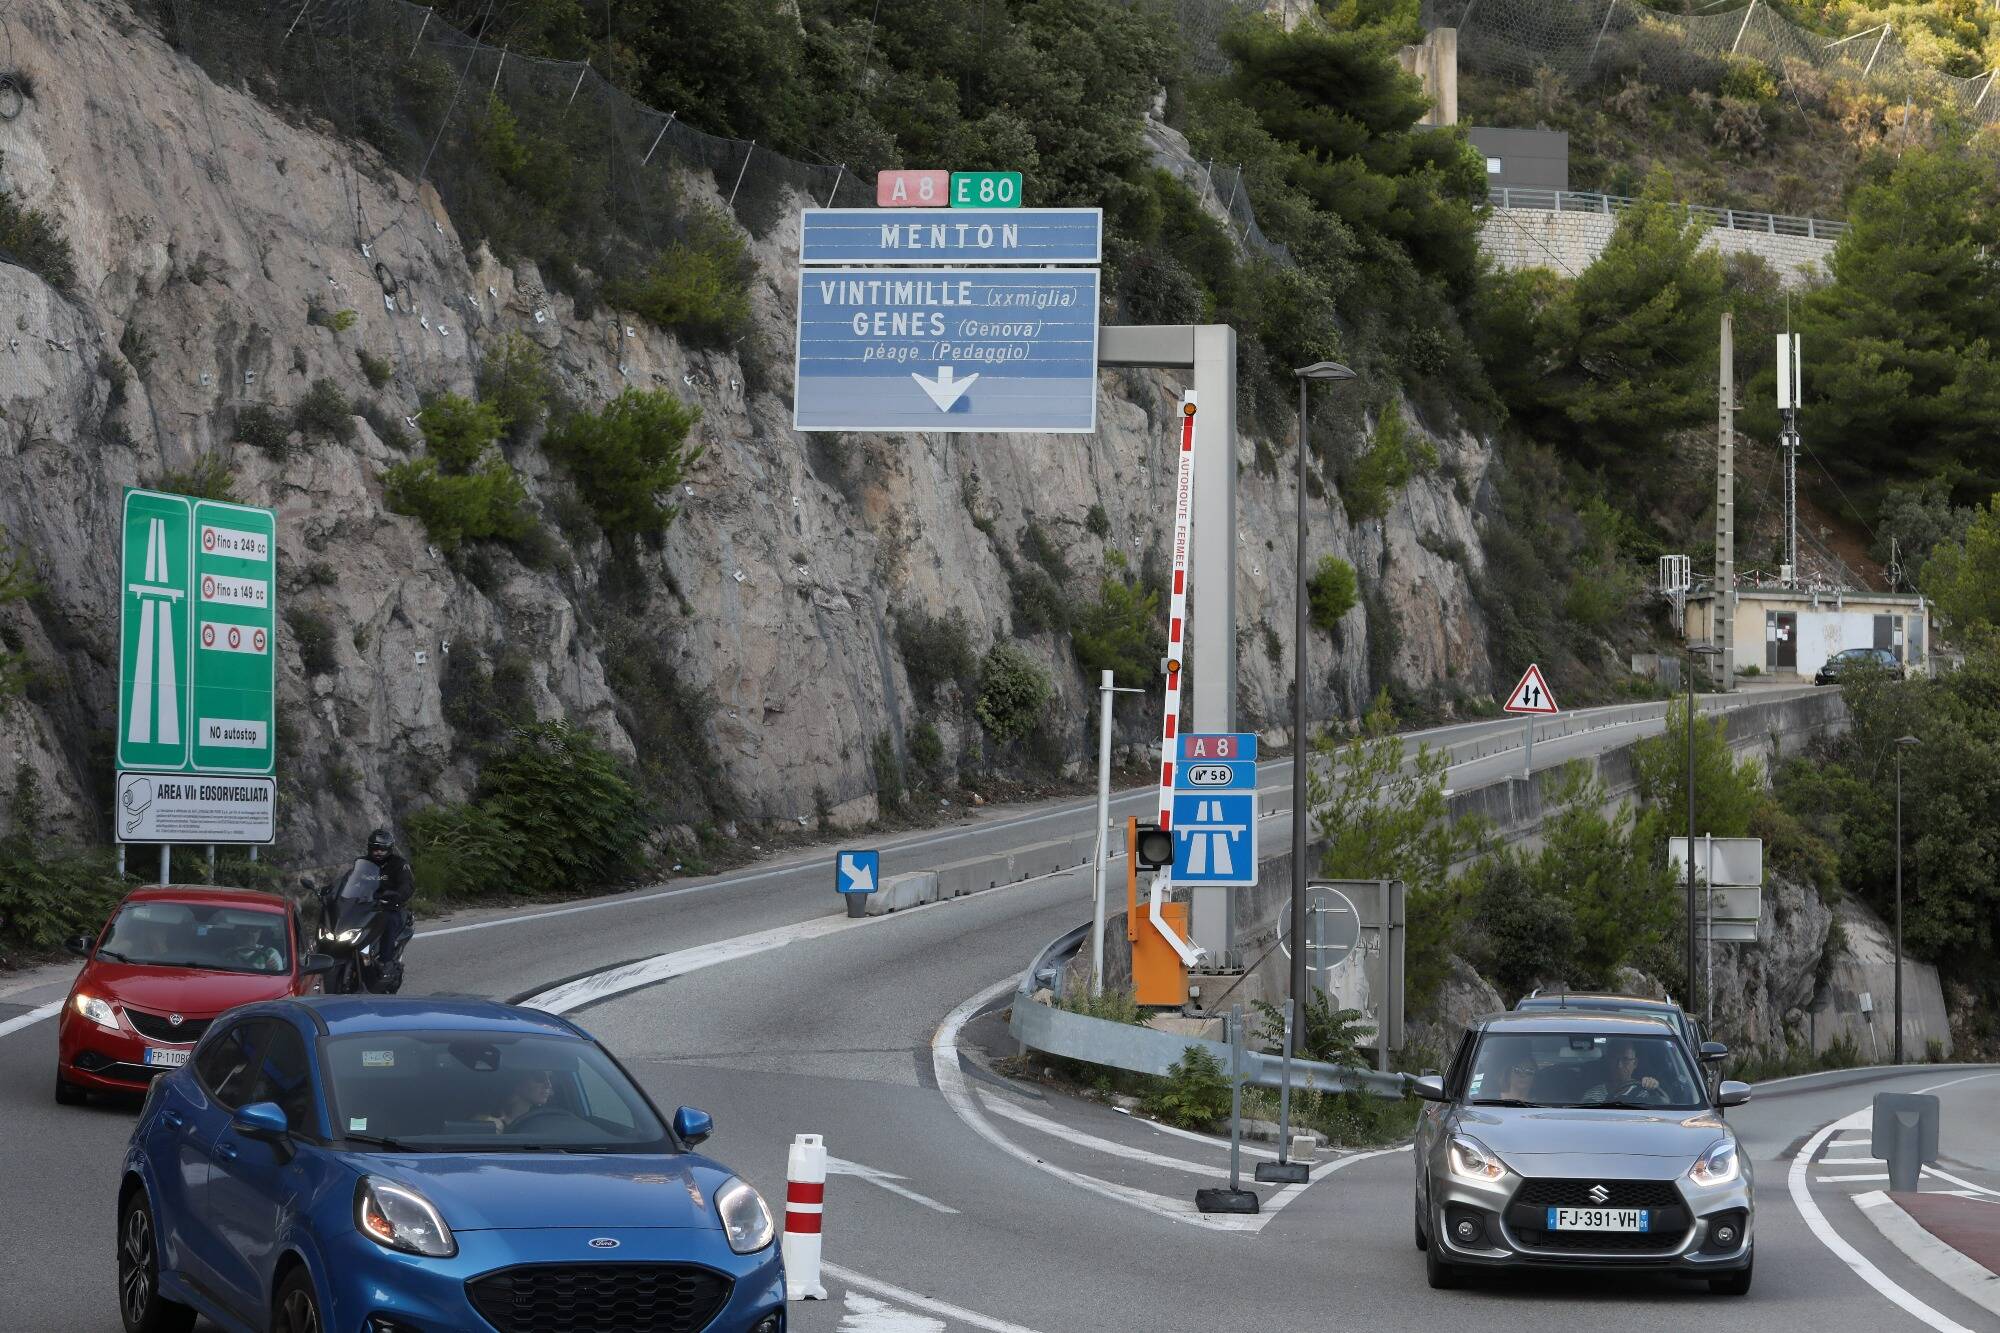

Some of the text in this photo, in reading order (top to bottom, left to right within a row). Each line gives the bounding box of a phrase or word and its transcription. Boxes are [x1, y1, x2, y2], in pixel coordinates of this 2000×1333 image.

[881, 224, 1018, 249] MENTON
[820, 281, 1077, 309] VINTIMILLE (xxmiglia)
[853, 312, 1042, 337] GENES (Genova)
[864, 341, 1030, 363] péage (Pedaggio)
[1175, 456, 1189, 567] AUTOROUTE FERMEE
[217, 534, 266, 554] fino a 249 cc
[217, 582, 264, 600] fino a 149 cc
[210, 726, 257, 744] NO autostop
[1210, 770, 1226, 781] 58
[157, 784, 182, 800] AREA
[1559, 1210, 1637, 1228] FJ-391-VH
